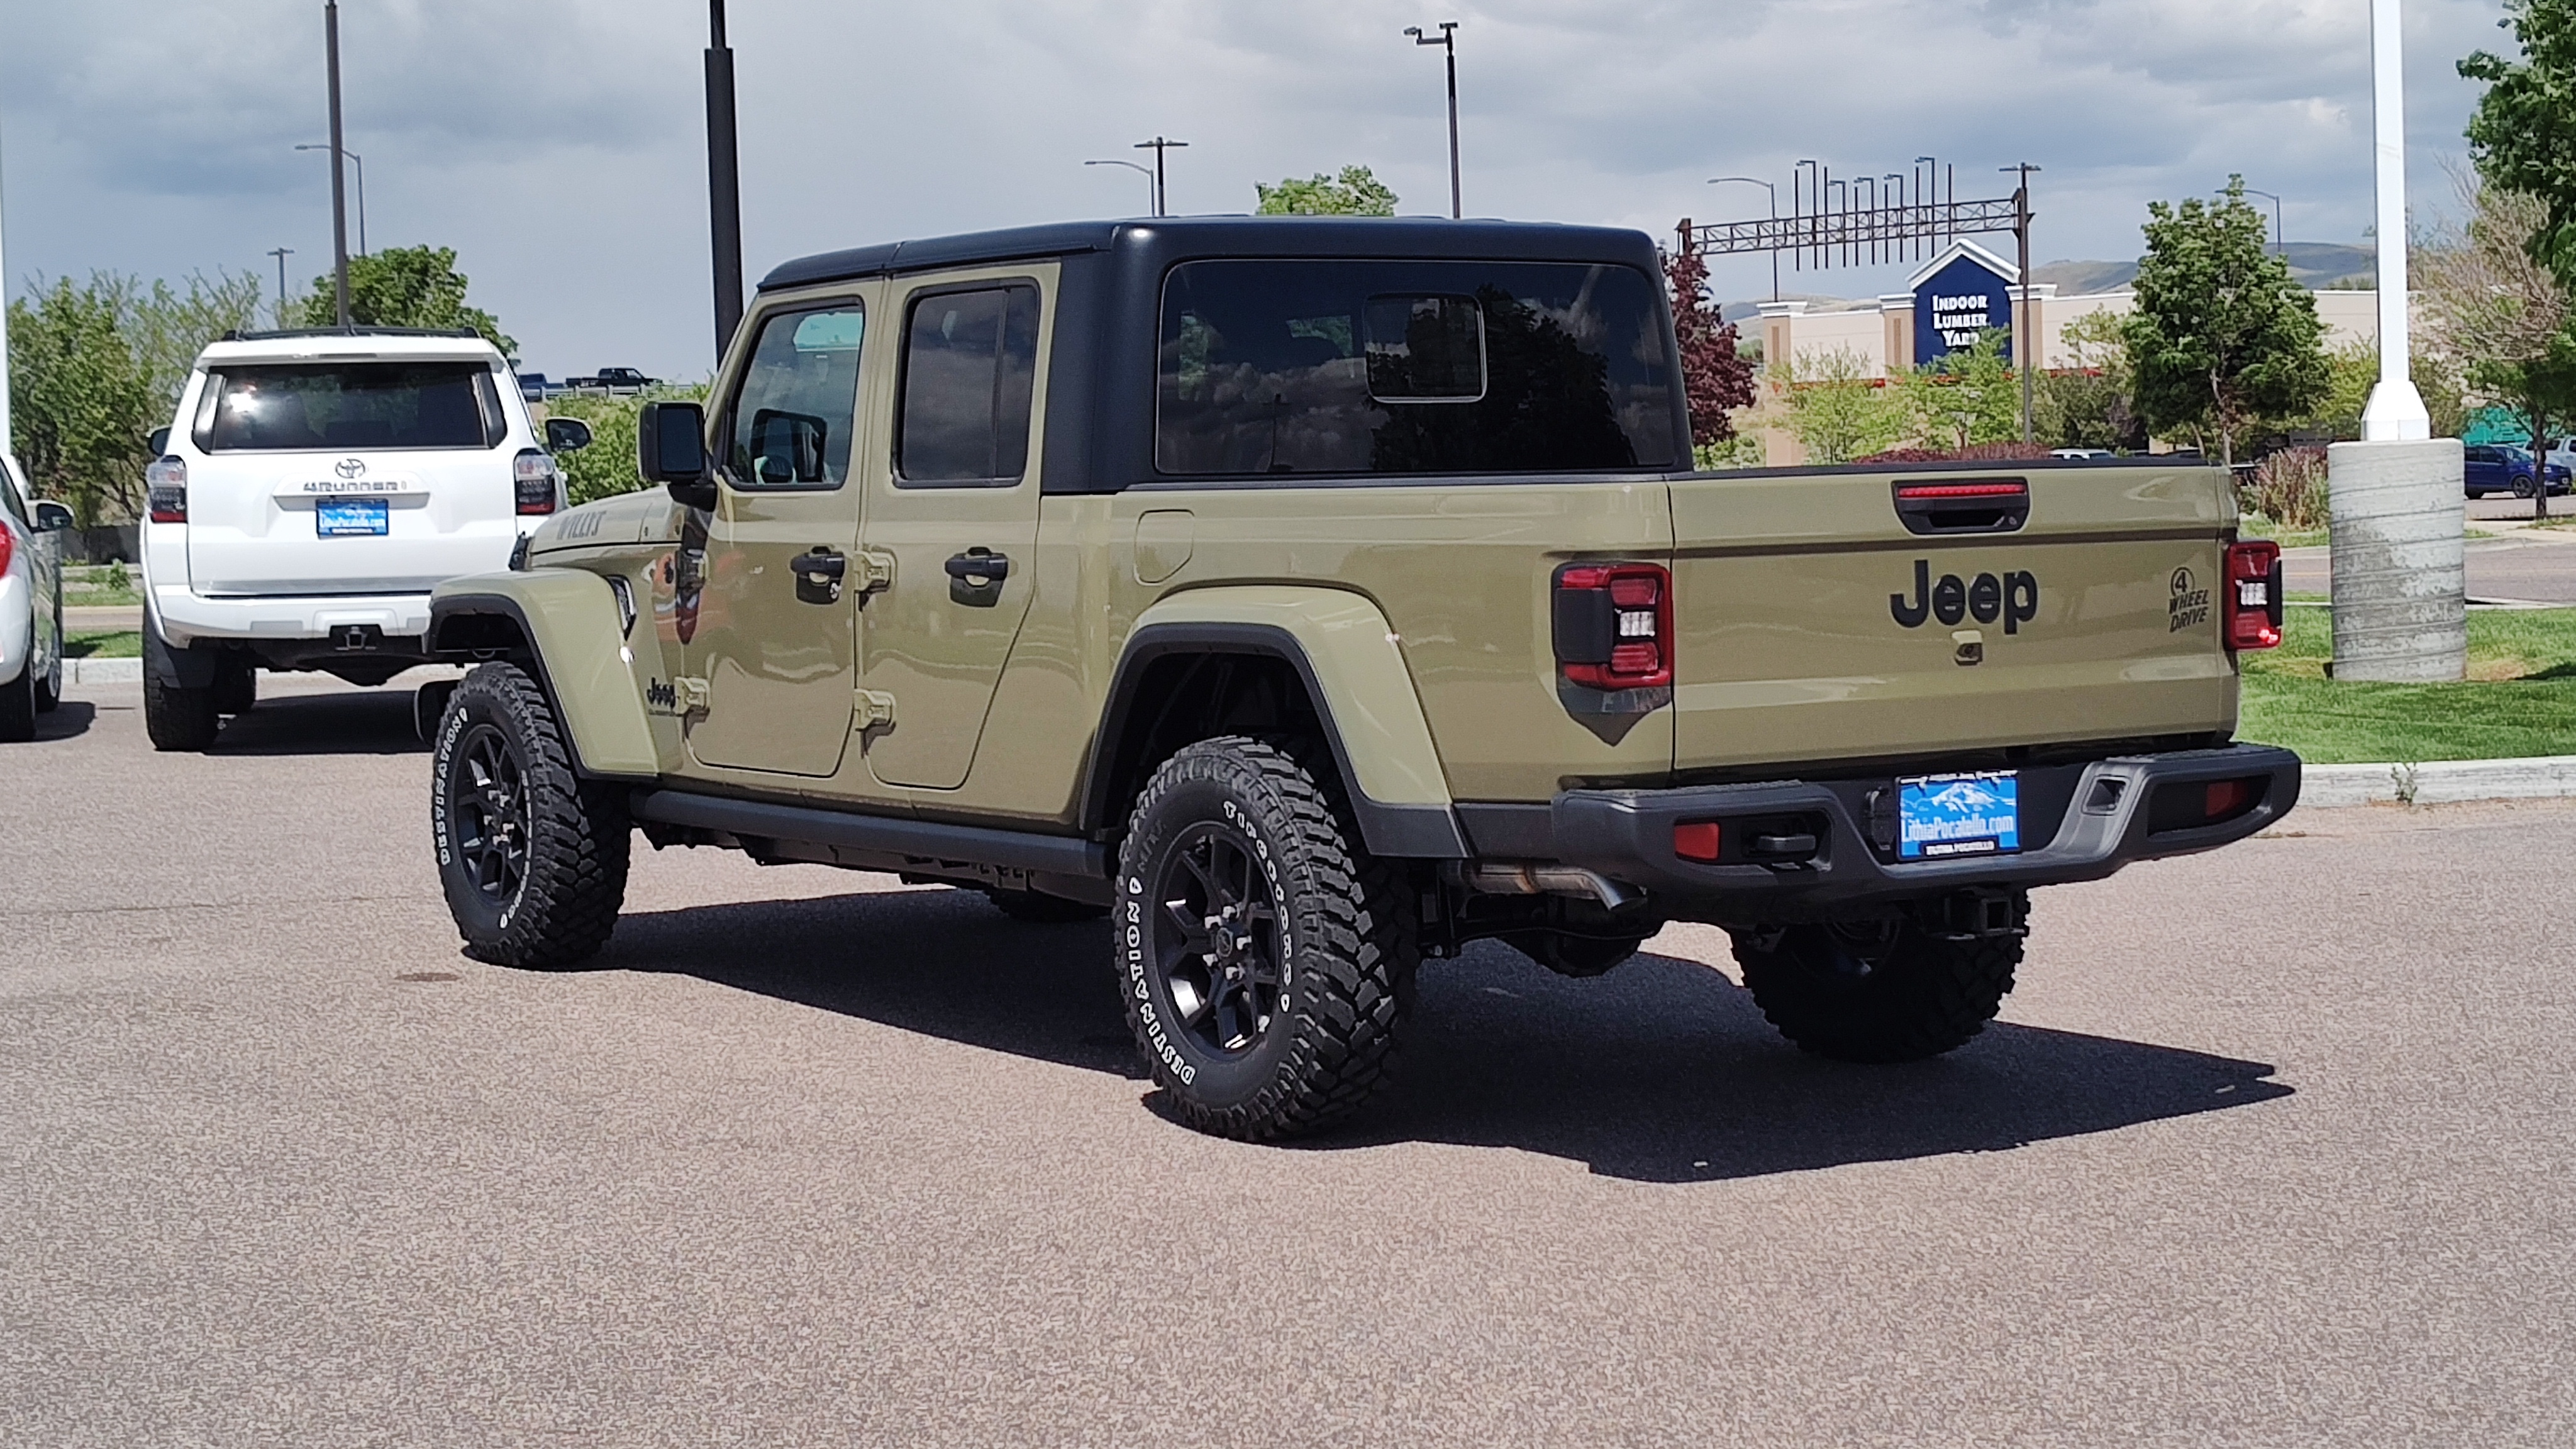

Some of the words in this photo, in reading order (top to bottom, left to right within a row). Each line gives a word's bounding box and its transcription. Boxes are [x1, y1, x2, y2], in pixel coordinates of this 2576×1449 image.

[1933, 295, 1988, 311] INDOOR
[1934, 313, 1987, 329] LUMBER
[1942, 330, 1980, 347] YARD
[303, 481, 398, 492] 4RUNNER
[557, 510, 607, 540] WILLYS
[1890, 559, 2038, 635] Jeep
[2168, 589, 2209, 614] WHEEL
[2169, 606, 2209, 633] DRIVE
[647, 677, 676, 708] Jeep
[435, 715, 462, 866] DESTINATION
[1901, 813, 2014, 843] LithiaPocatello.com
[1126, 901, 1196, 1085] DESTINATION
